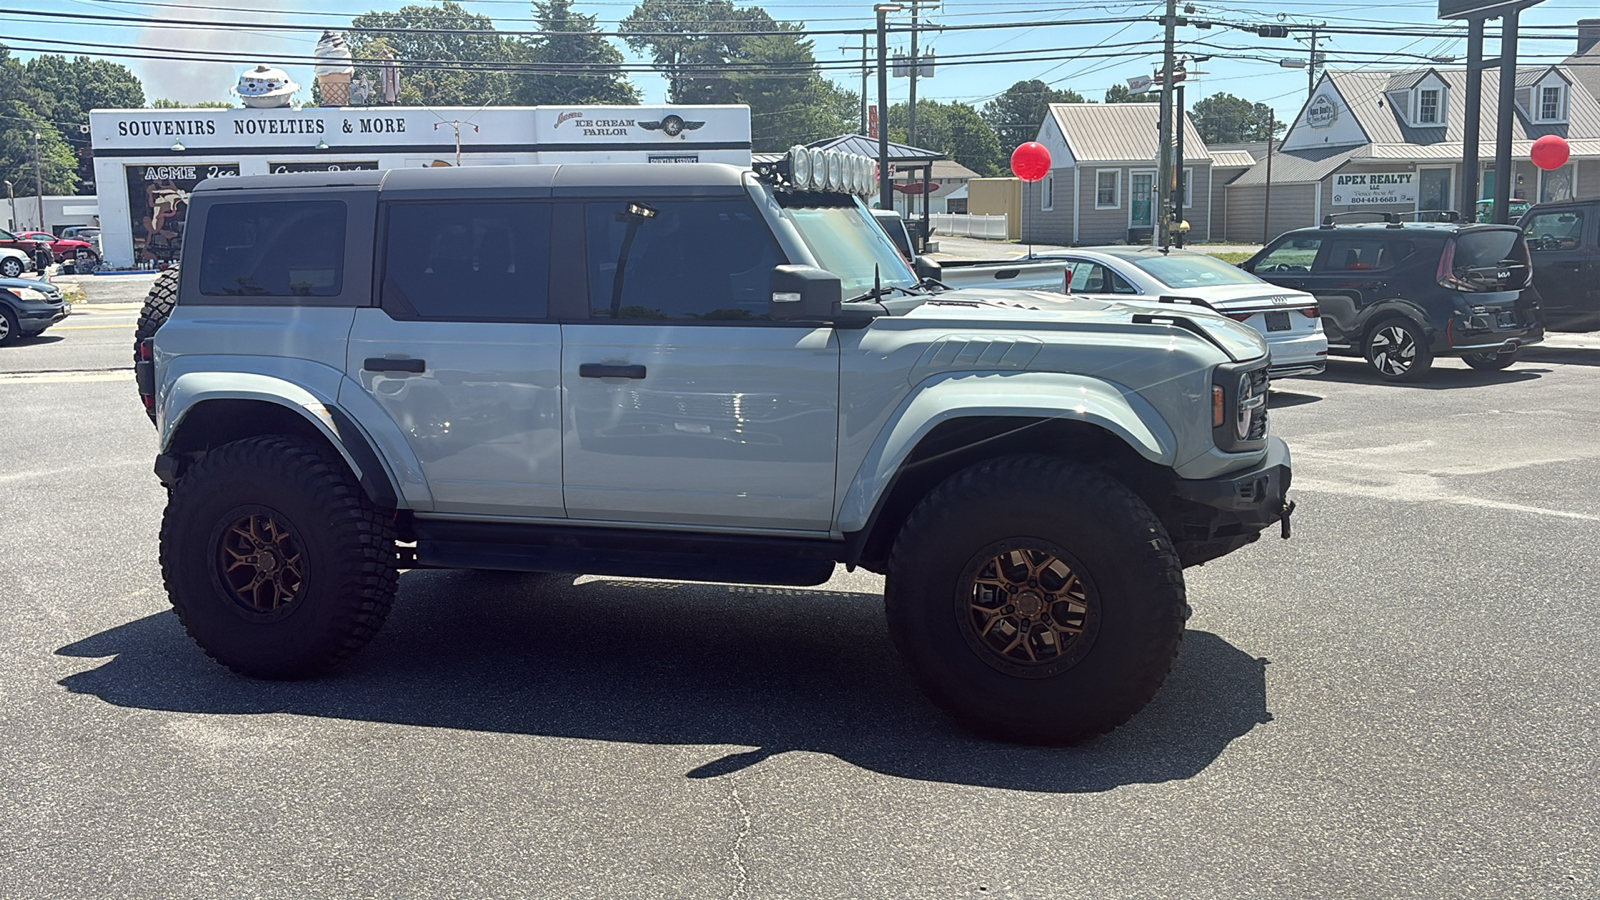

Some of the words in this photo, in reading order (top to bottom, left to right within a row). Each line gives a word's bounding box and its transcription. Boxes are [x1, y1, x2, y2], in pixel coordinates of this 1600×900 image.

[118, 120, 215, 136] SOUVENIRS
[234, 119, 325, 134] NOVELTIES
[342, 119, 353, 133] &
[360, 118, 406, 133] MORE
[595, 119, 635, 127] CREAM
[583, 128, 628, 136] PARLOR
[145, 166, 196, 180] ACME
[1337, 175, 1366, 185] APEX
[1370, 174, 1412, 184] REALTY
